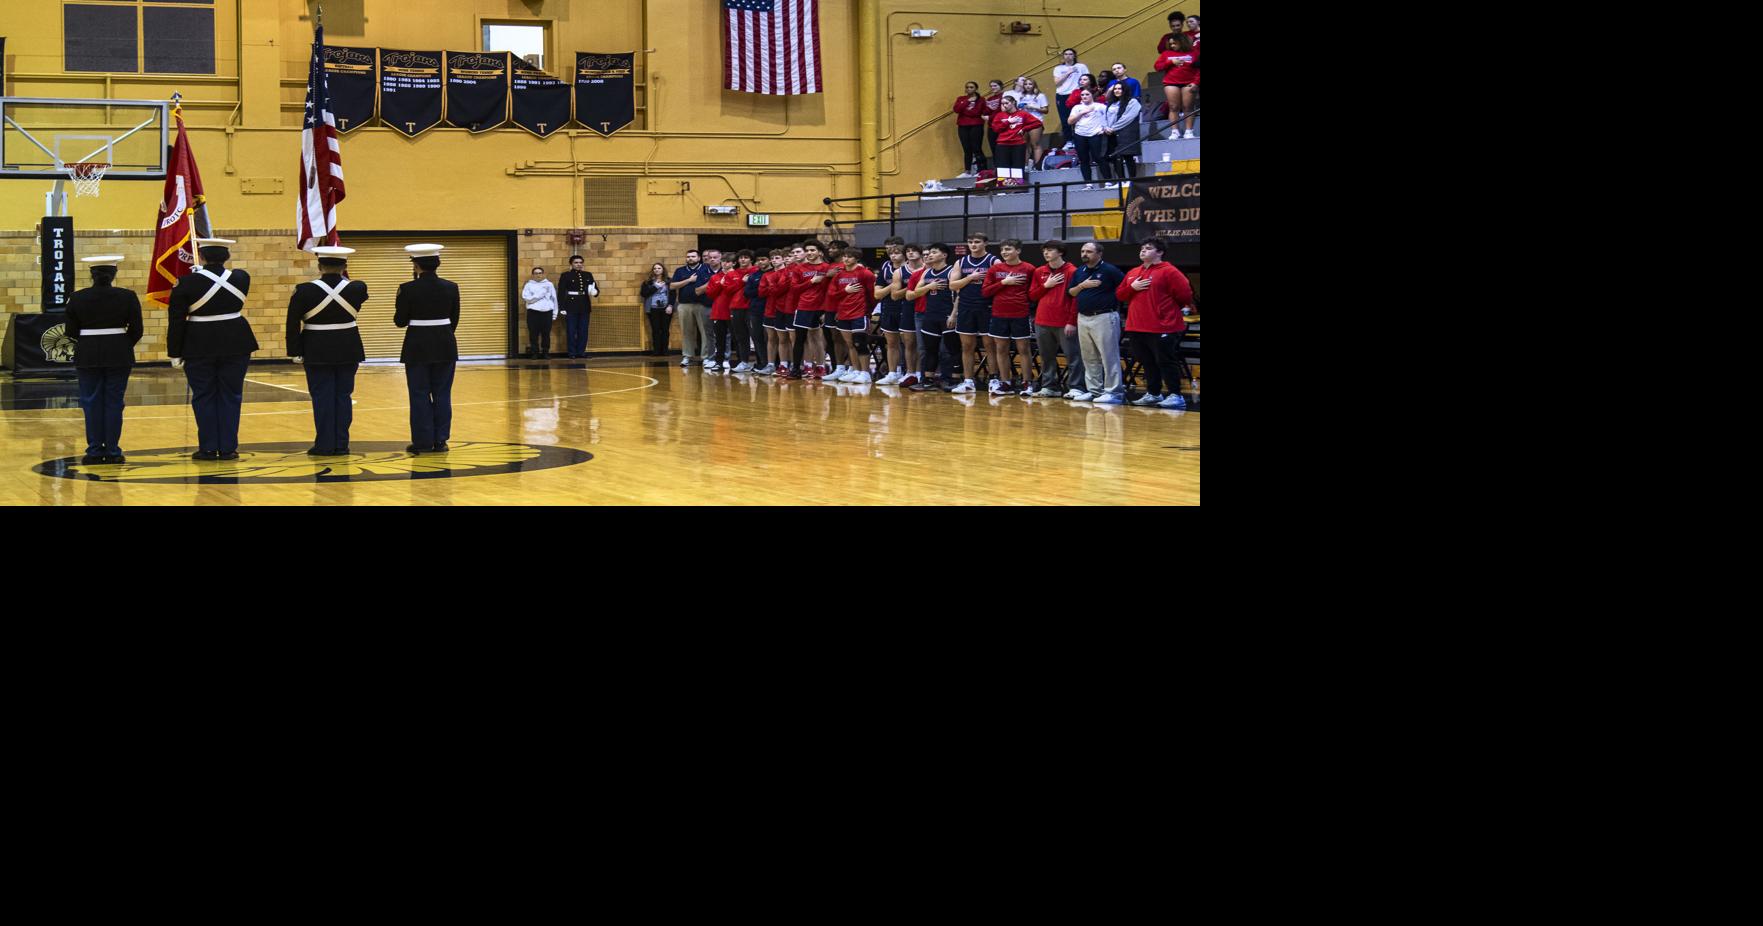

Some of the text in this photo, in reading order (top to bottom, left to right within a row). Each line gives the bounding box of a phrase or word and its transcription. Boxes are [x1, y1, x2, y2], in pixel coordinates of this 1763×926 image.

[383, 52, 440, 67] Trojans
[449, 54, 504, 69] Trojans
[578, 55, 631, 69] Trojans
[338, 118, 349, 130] T
[405, 122, 416, 133] T
[537, 123, 548, 134] T
[600, 122, 611, 133] T
[752, 215, 766, 225] EXIT
[1143, 207, 1200, 223] THE DU
[53, 228, 65, 304] TROJANS
